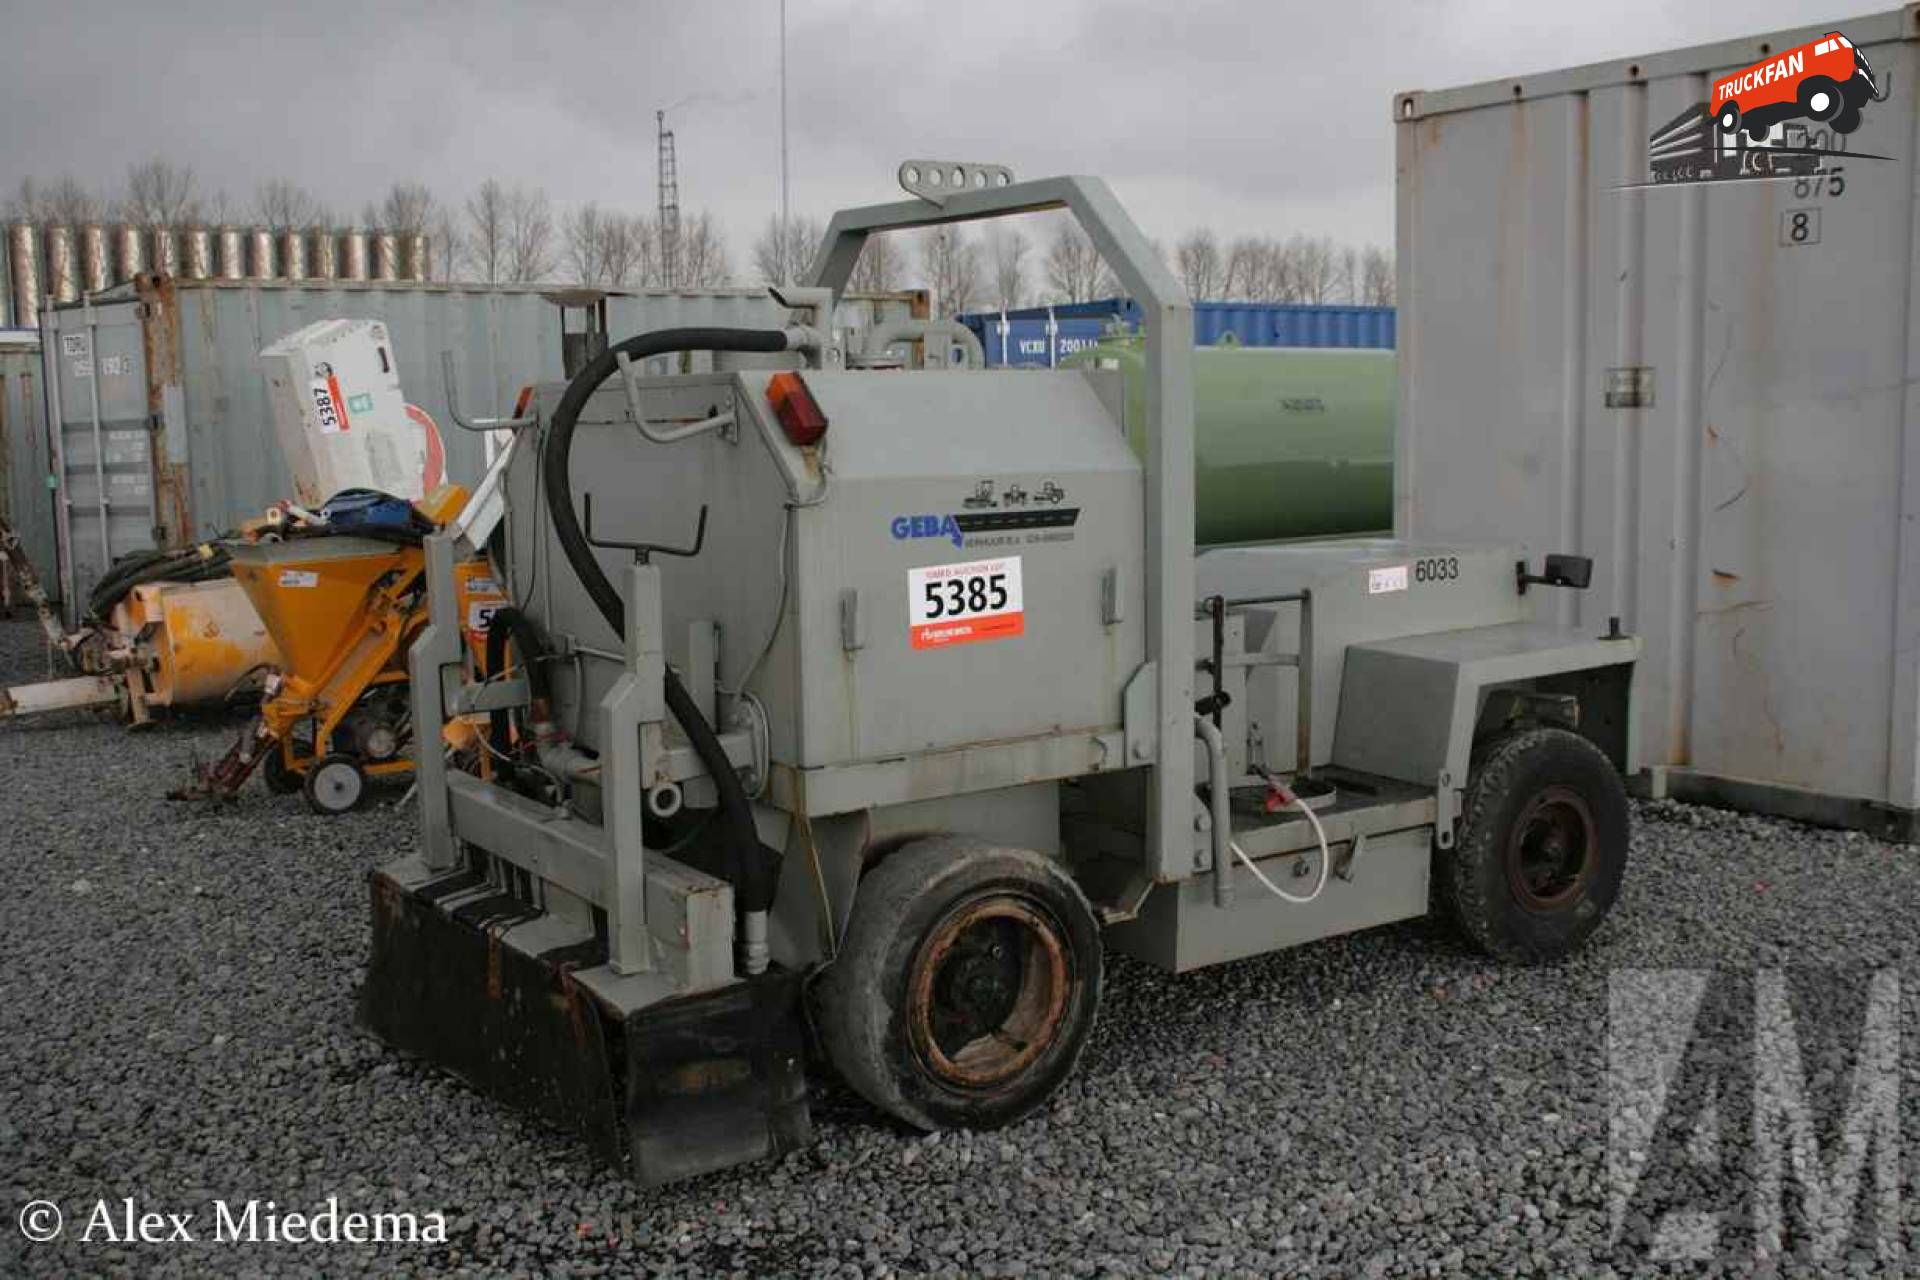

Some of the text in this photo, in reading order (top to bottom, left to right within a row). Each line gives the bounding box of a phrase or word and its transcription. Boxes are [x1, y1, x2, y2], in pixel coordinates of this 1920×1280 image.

[1791, 212, 1809, 242] 8
[313, 387, 338, 426] 5387
[891, 515, 962, 545] GEBA
[1415, 557, 1459, 582] 6033
[925, 574, 1008, 619] 5385
